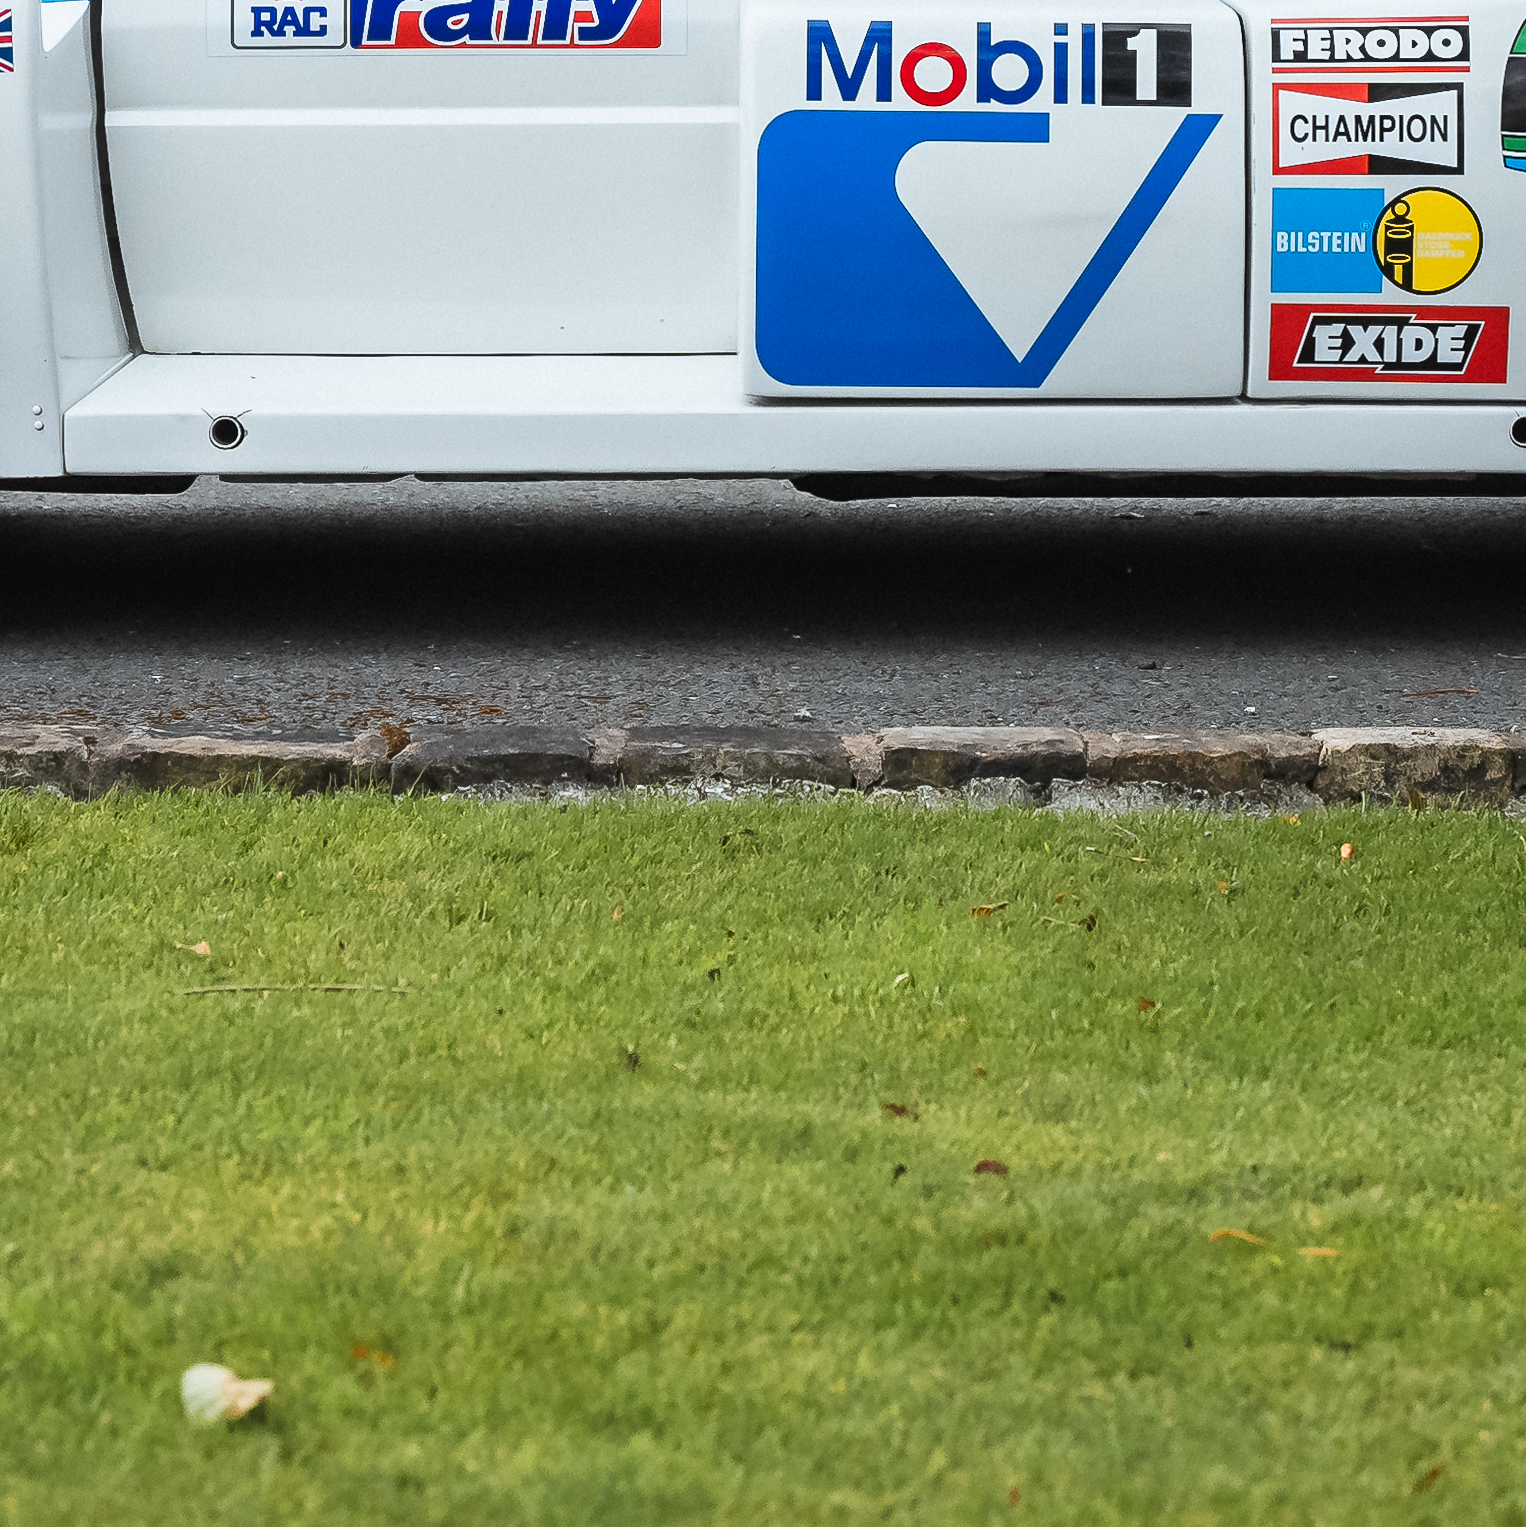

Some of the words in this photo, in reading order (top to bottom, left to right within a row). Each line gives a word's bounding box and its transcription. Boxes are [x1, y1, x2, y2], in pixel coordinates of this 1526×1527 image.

[250, 5, 328, 38] RAC
[1278, 27, 1464, 61] FERODO
[805, 19, 1096, 107] Mobil
[1125, 27, 1159, 101] 1
[1289, 113, 1449, 143] CHAMPION
[1276, 231, 1367, 254] BILSTEIN
[1416, 231, 1473, 241] GASDRUCK
[1311, 323, 1469, 363] EXIDE
